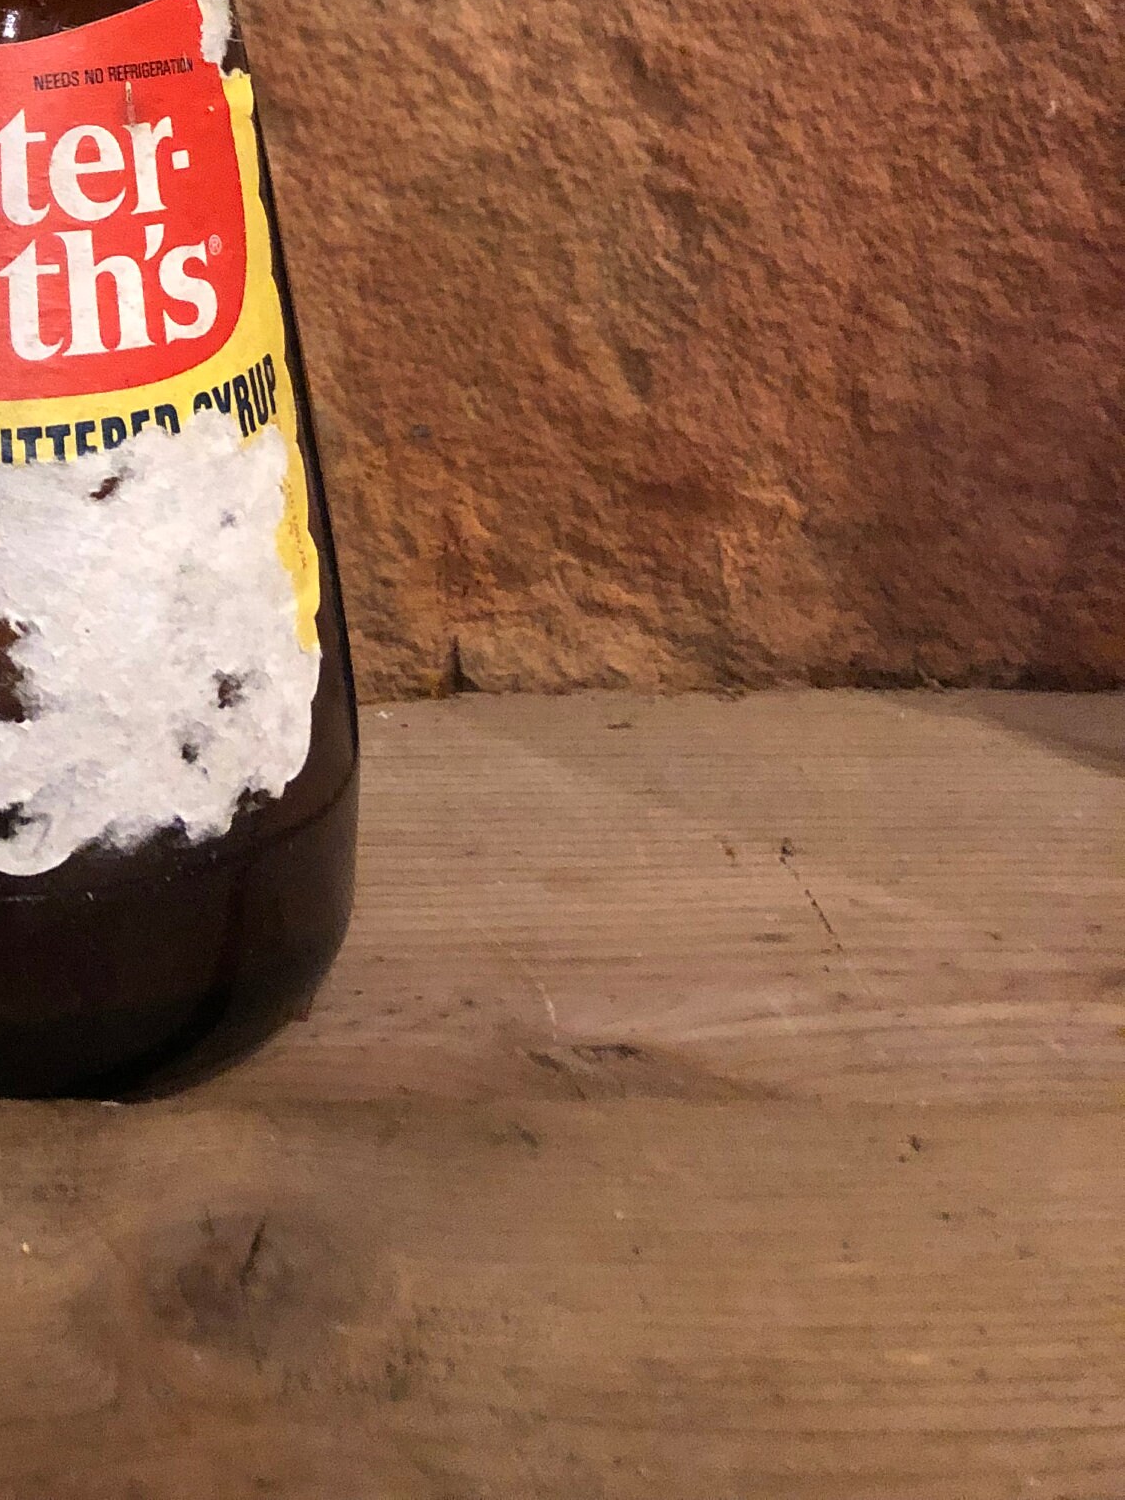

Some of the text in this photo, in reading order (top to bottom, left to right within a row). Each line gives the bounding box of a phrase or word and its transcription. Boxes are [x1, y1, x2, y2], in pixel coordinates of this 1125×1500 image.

[33, 57, 194, 91] NEEDS NO REFRIGERATION
